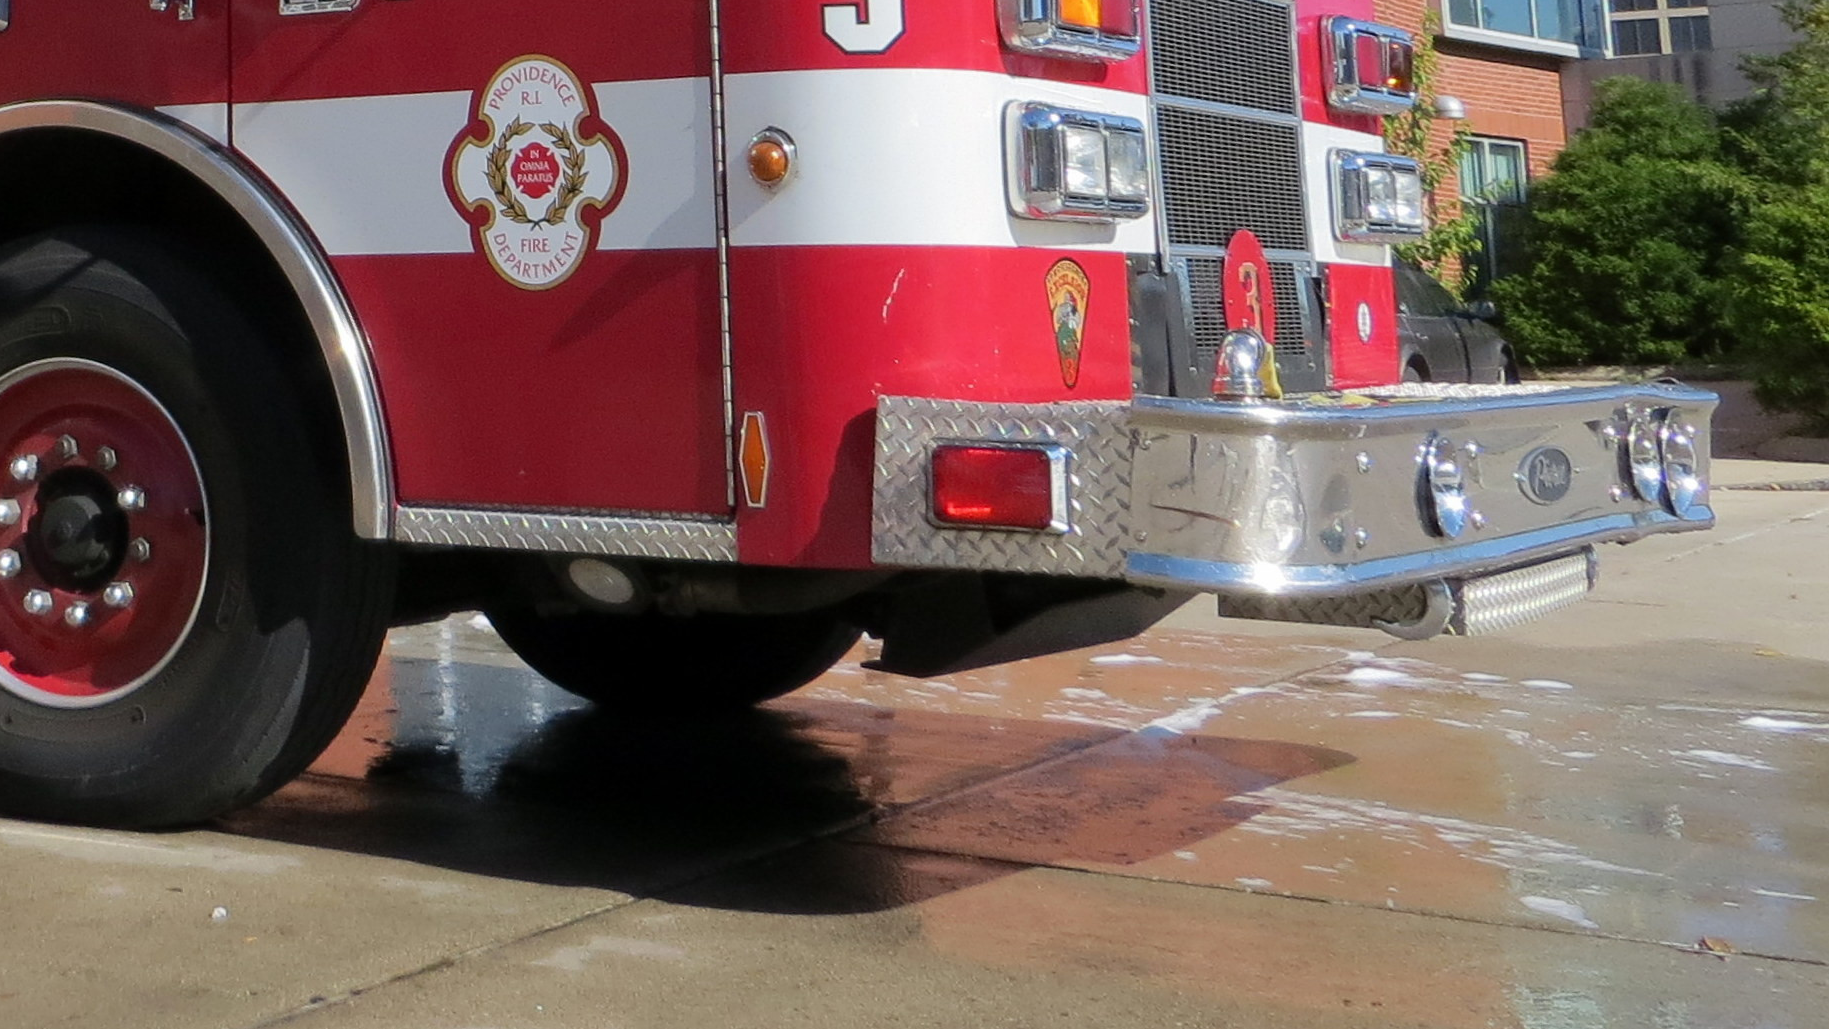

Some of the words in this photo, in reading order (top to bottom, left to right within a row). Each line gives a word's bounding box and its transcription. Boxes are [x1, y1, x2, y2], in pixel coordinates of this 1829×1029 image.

[488, 66, 575, 110] PROVIDENCE
[521, 91, 542, 106] R.I.
[529, 149, 540, 159] IN
[517, 173, 554, 183] PARATUS
[520, 238, 551, 253] FIRE
[493, 231, 579, 279] DEPARTMENT
